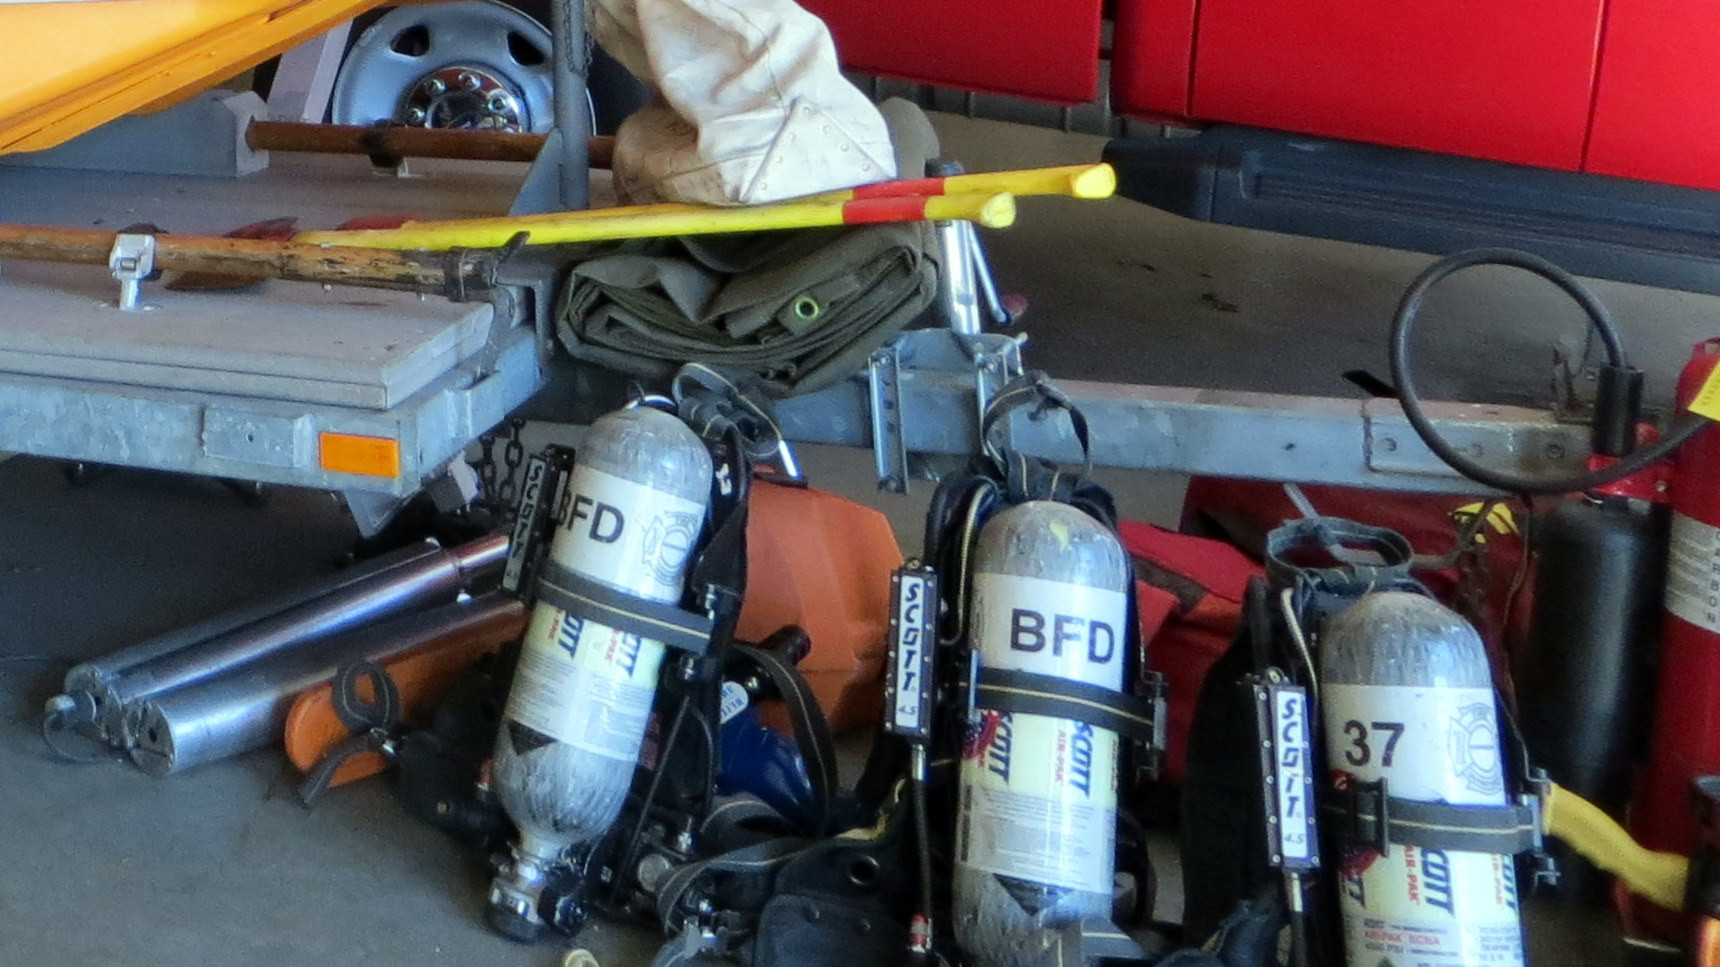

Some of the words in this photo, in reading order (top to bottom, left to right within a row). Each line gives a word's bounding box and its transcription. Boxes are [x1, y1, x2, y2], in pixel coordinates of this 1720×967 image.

[902, 582, 921, 693] SCOTT
[1009, 607, 1116, 665] BFD
[1281, 697, 1302, 819] SCOTT
[1343, 719, 1406, 768] 37
[1421, 848, 1455, 916] COTT
